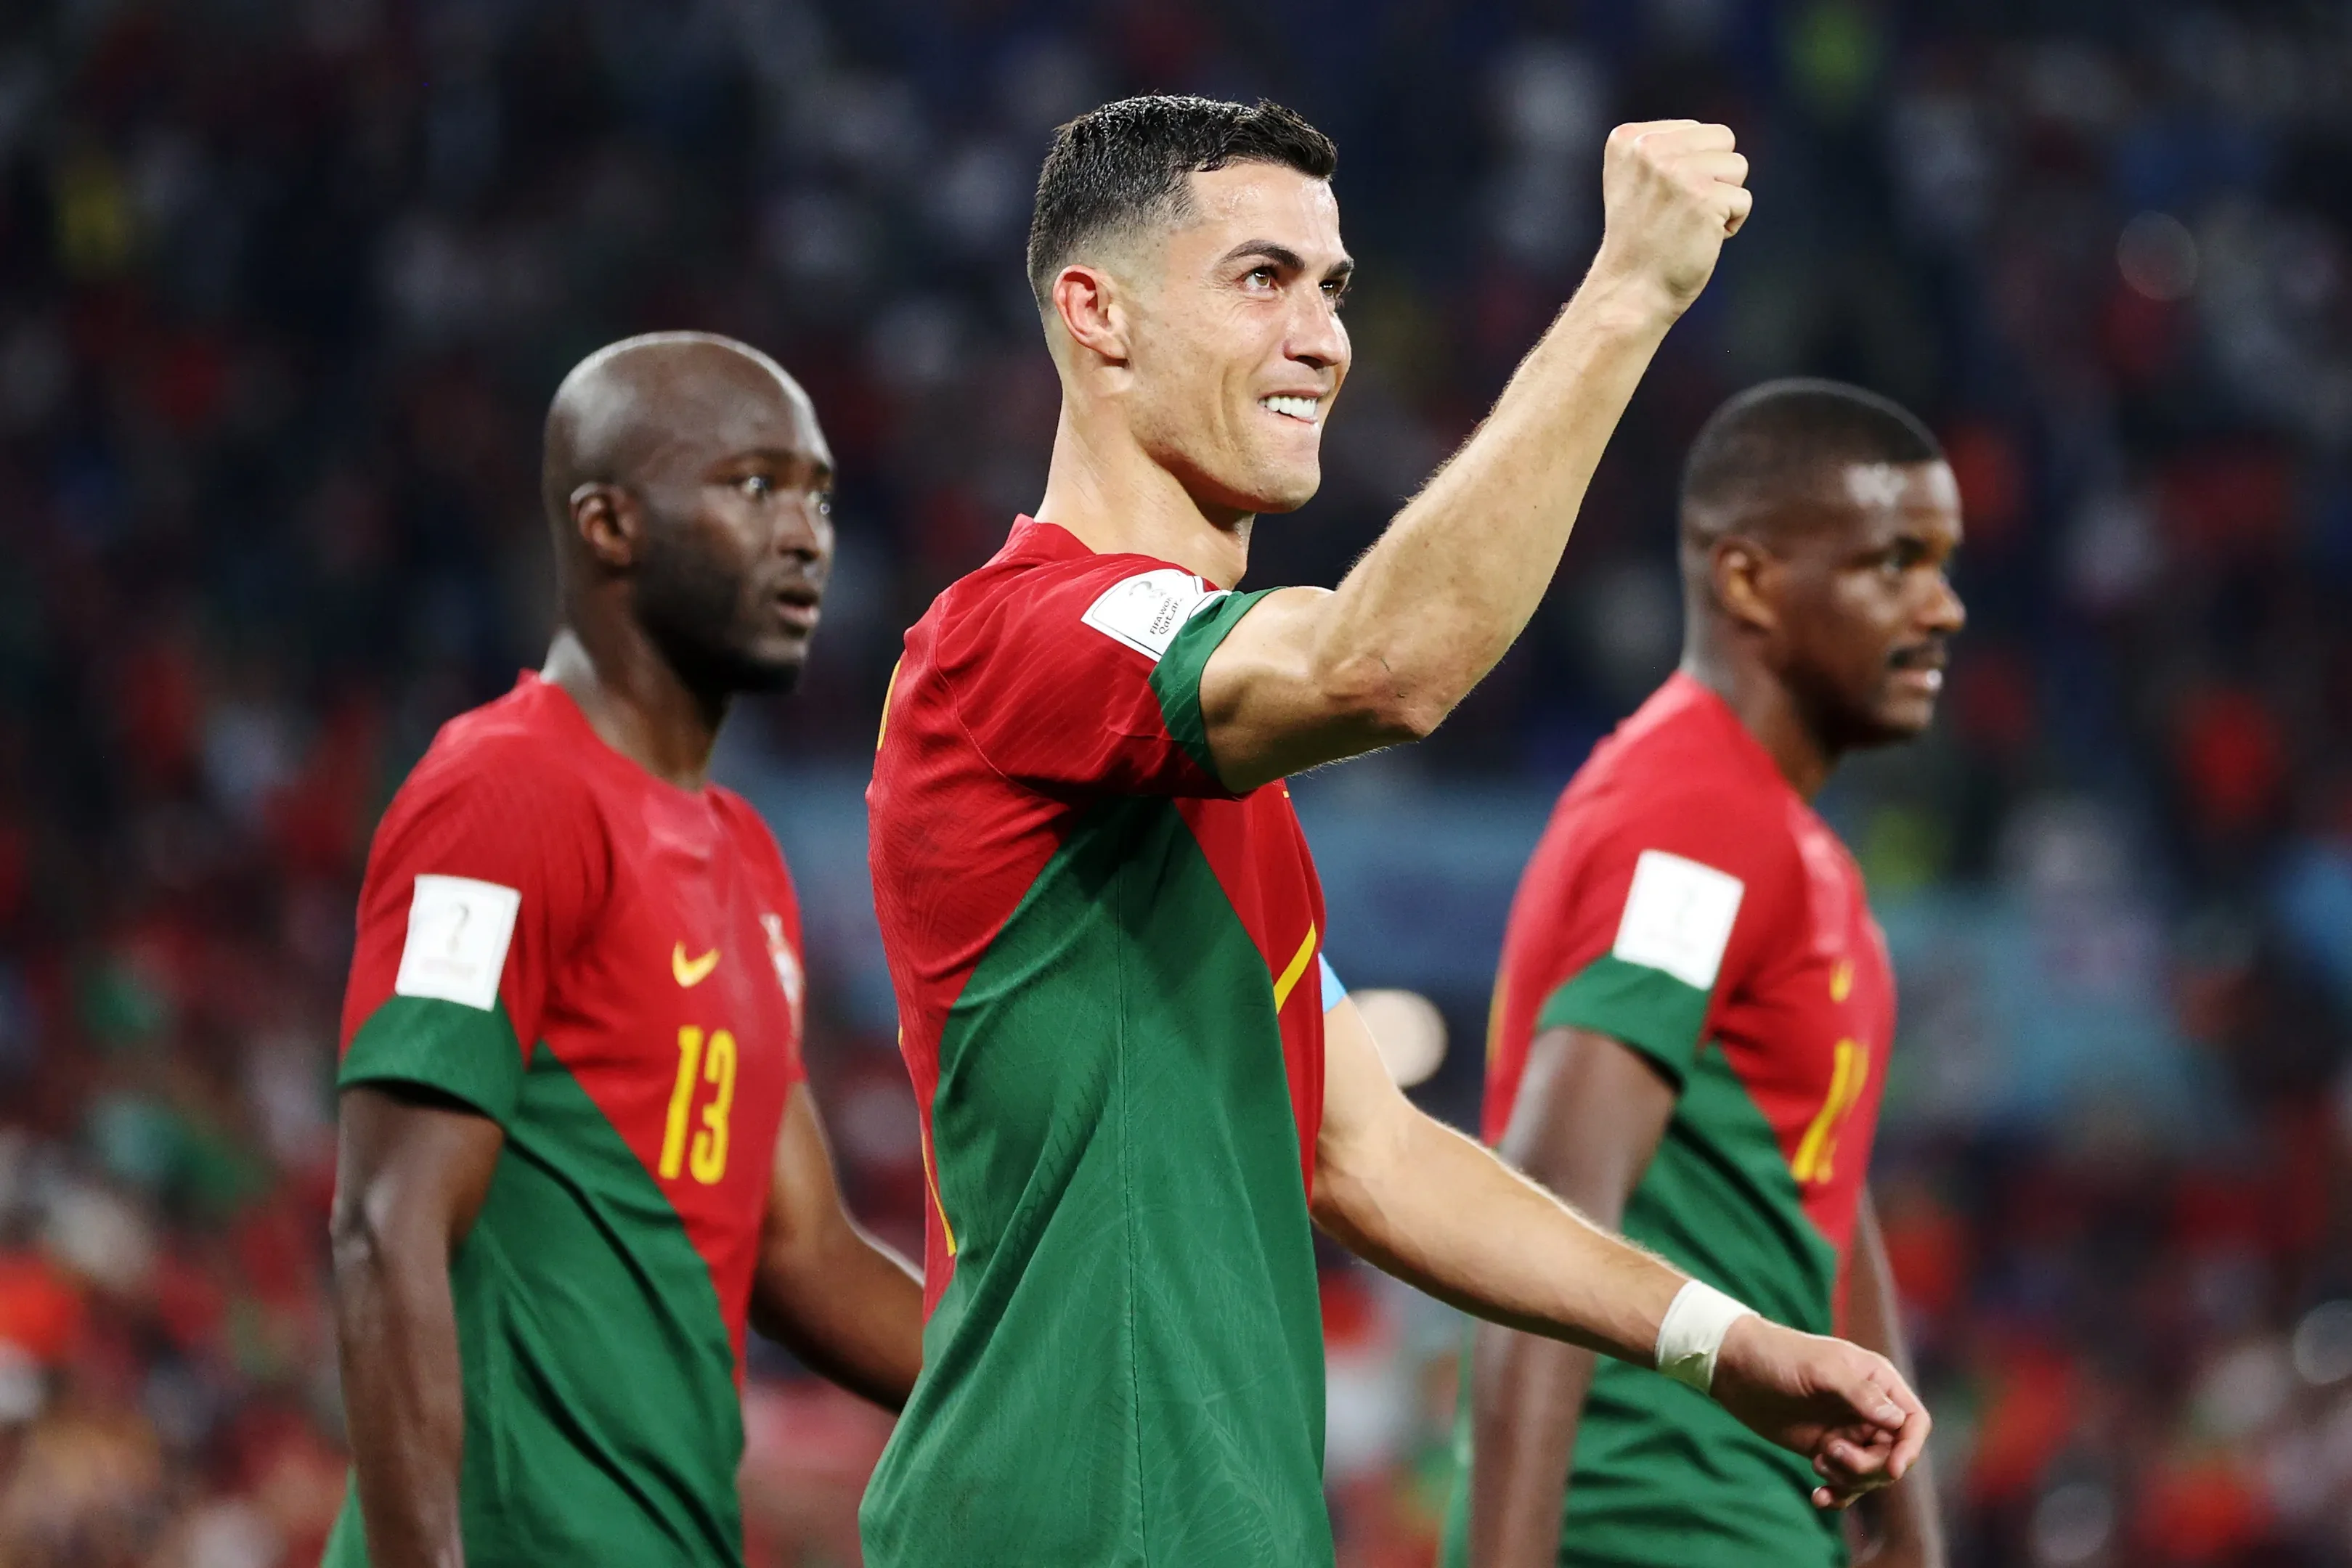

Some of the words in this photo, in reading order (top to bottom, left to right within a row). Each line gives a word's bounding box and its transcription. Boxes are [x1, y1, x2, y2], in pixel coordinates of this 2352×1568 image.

[1149, 616, 1163, 634] FIFA
[1159, 601, 1179, 634] Qatar
[658, 1024, 738, 1185] 13
